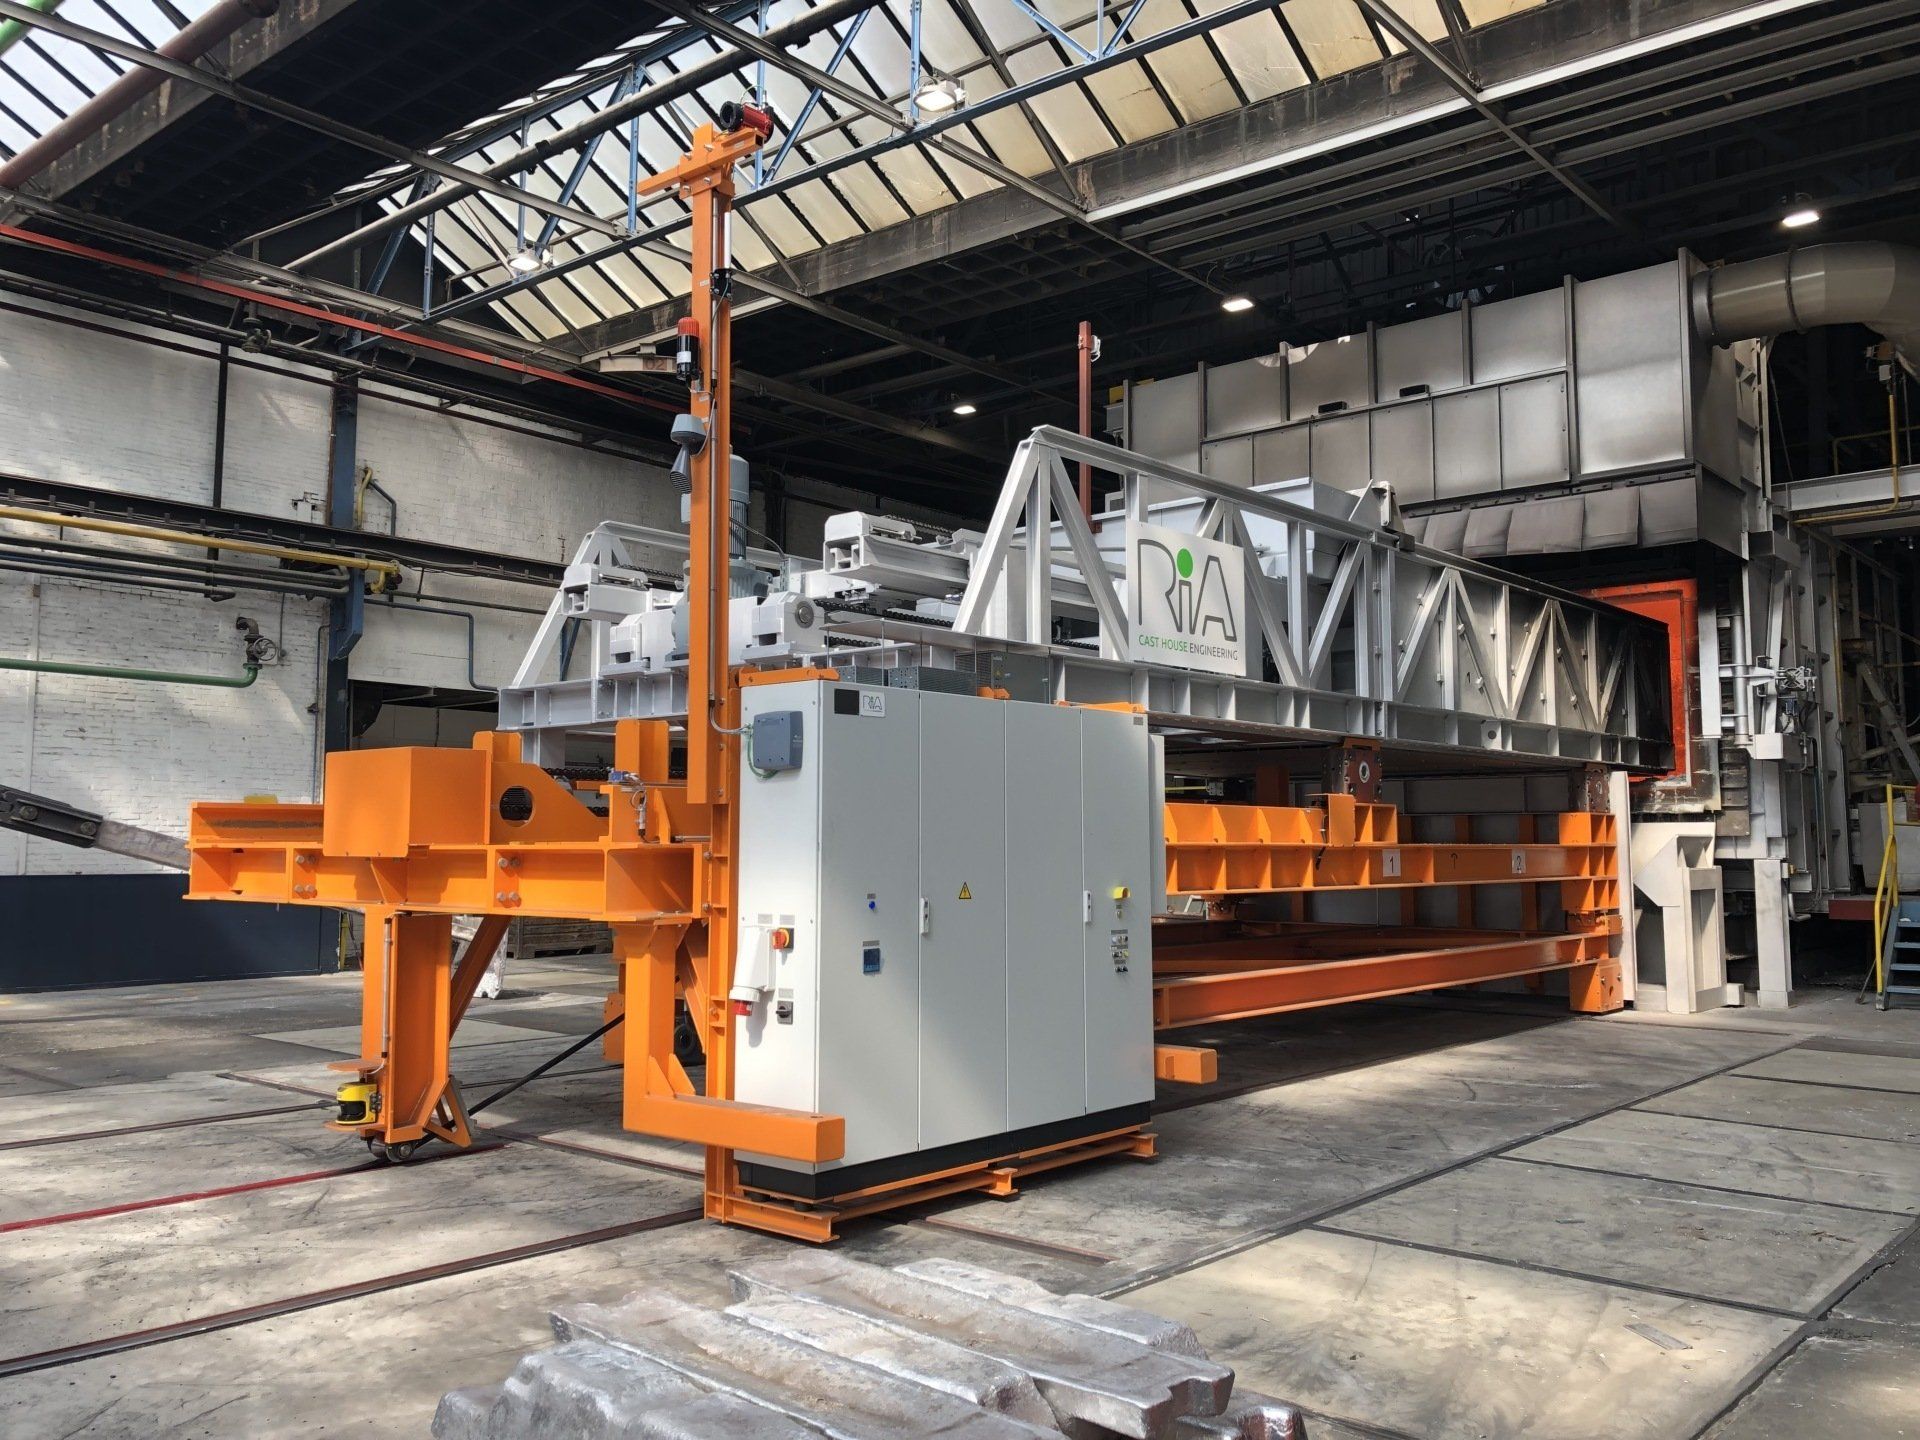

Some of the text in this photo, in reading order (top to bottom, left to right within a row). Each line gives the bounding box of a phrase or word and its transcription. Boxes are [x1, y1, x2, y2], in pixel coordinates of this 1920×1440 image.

[1138, 634, 1239, 661] CAST HOUSE ENGINEERING
[1389, 855, 1395, 874] 1
